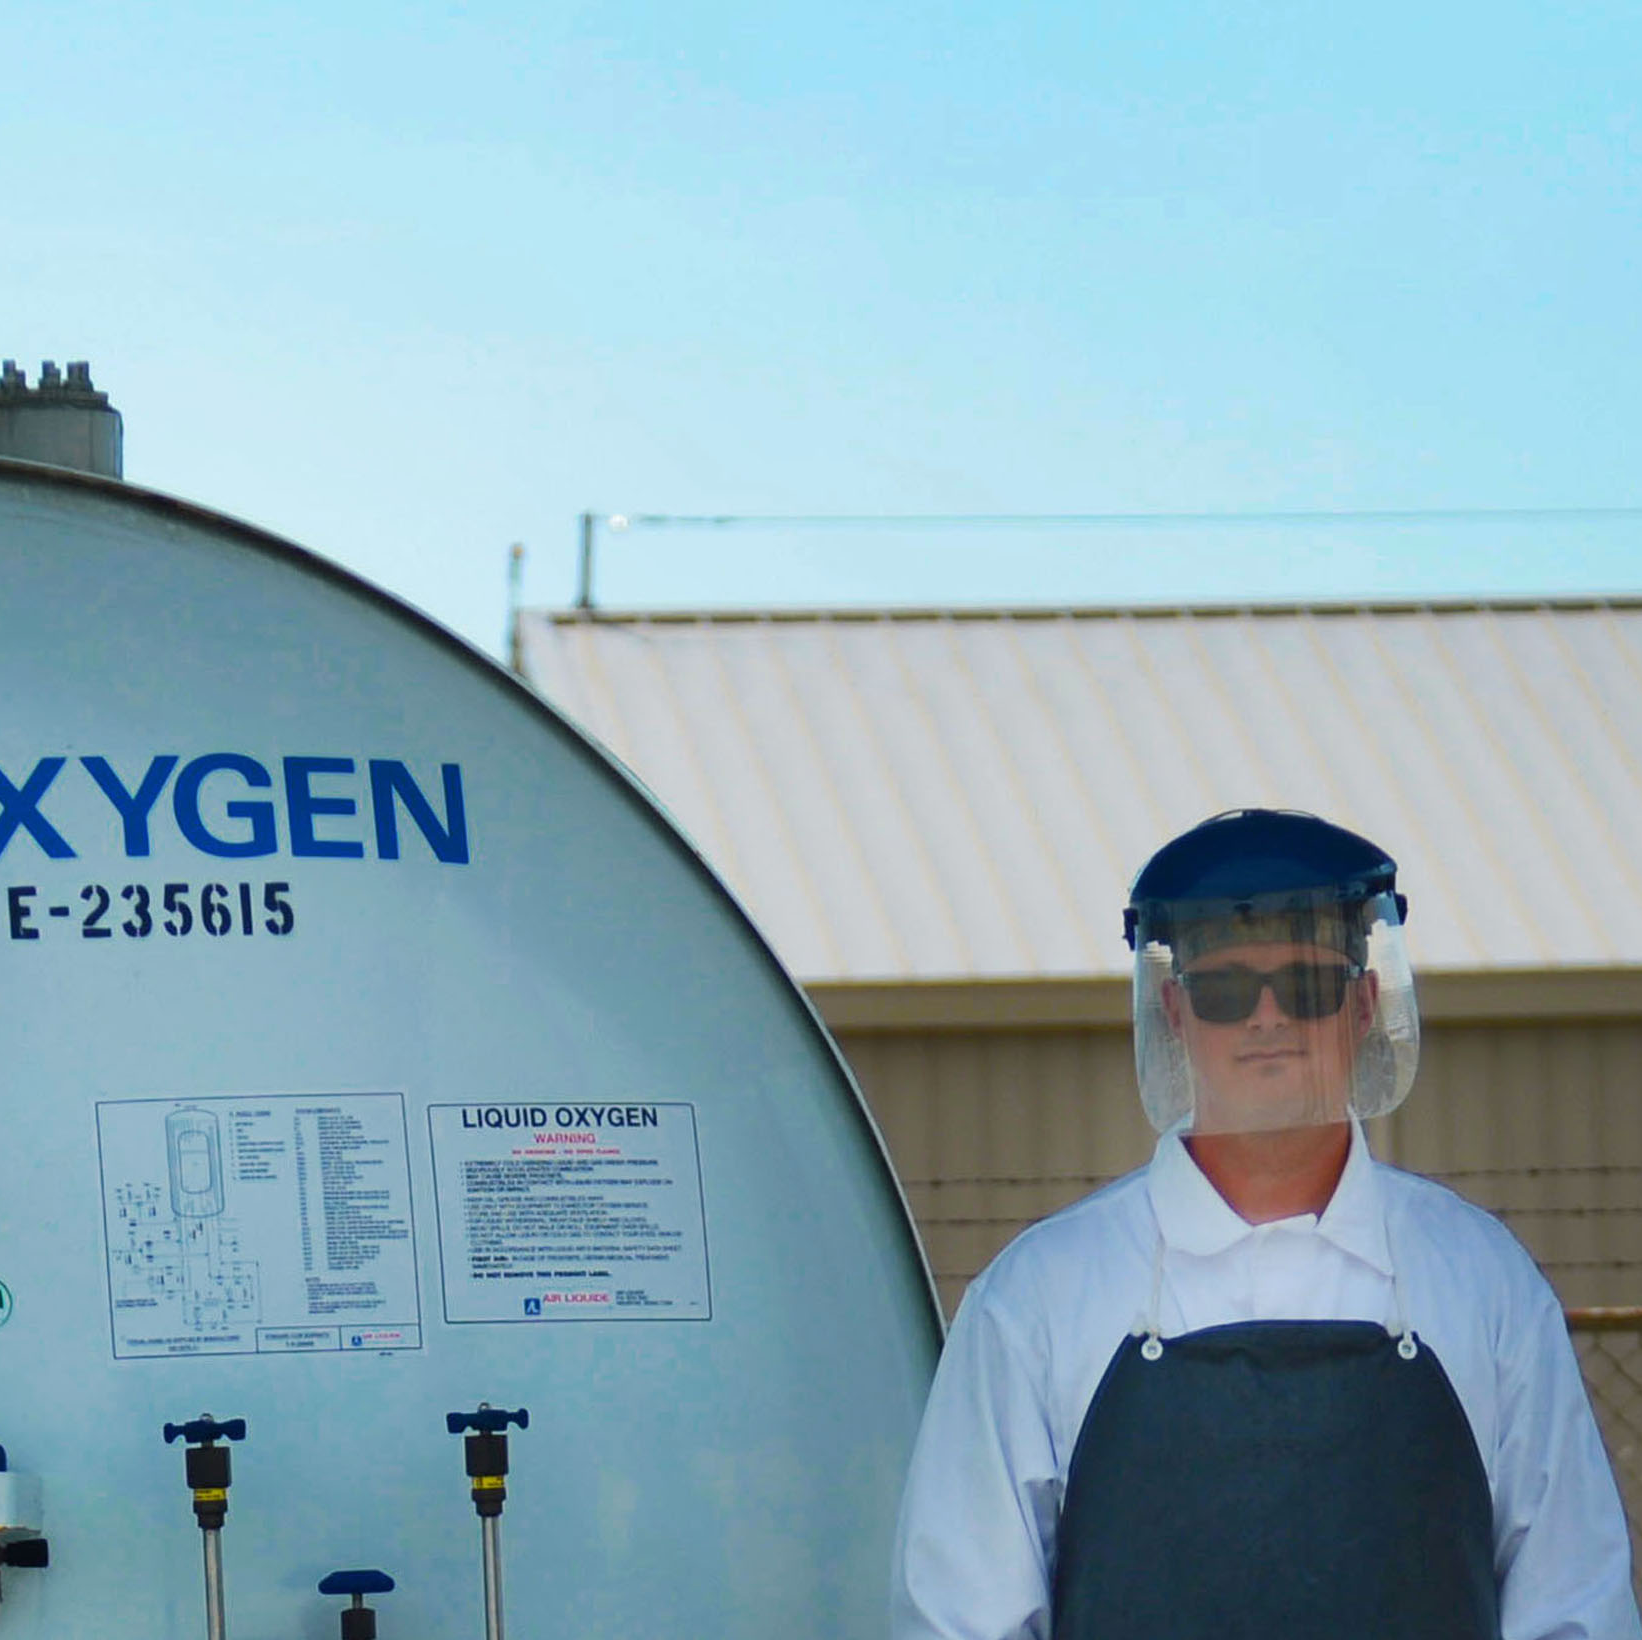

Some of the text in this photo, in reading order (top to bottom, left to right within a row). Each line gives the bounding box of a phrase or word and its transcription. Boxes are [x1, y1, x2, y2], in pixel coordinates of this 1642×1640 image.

[7, 882, 295, 940] E-235615
[462, 1107, 658, 1128] LIQUID OXYGEN
[534, 1133, 596, 1144] WARNING
